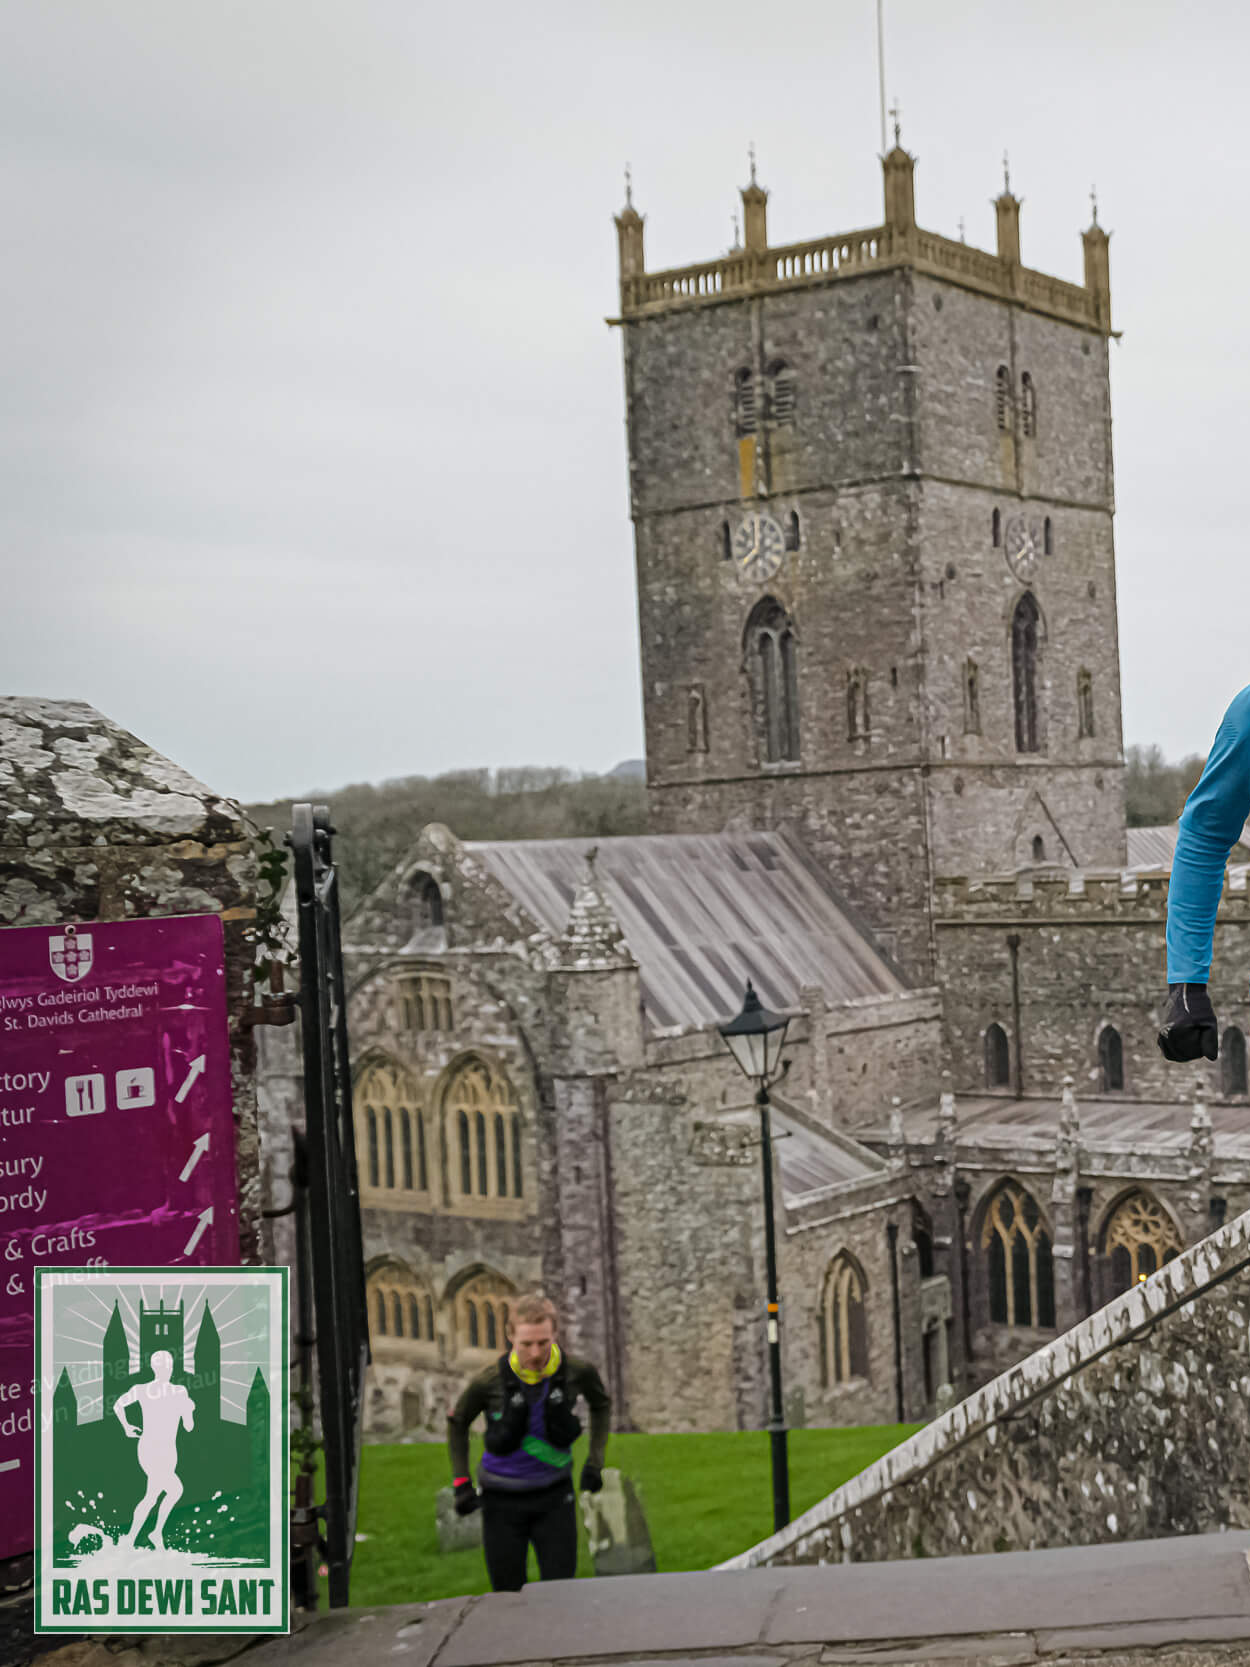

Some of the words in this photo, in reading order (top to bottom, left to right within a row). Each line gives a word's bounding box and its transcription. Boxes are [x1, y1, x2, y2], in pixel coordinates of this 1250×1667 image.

[0, 995, 34, 1012] lwys
[37, 987, 100, 1007] Gadeiriol
[103, 982, 159, 1003] Tyddewi
[4, 1016, 23, 1031] St.
[27, 1010, 74, 1029] Davids
[78, 1003, 144, 1023] Cathedral
[0, 1071, 50, 1094] tory
[4, 1239, 24, 1261] &
[31, 1226, 96, 1256] Crafts
[6, 1273, 25, 1296] &
[0, 1408, 32, 1436] dd
